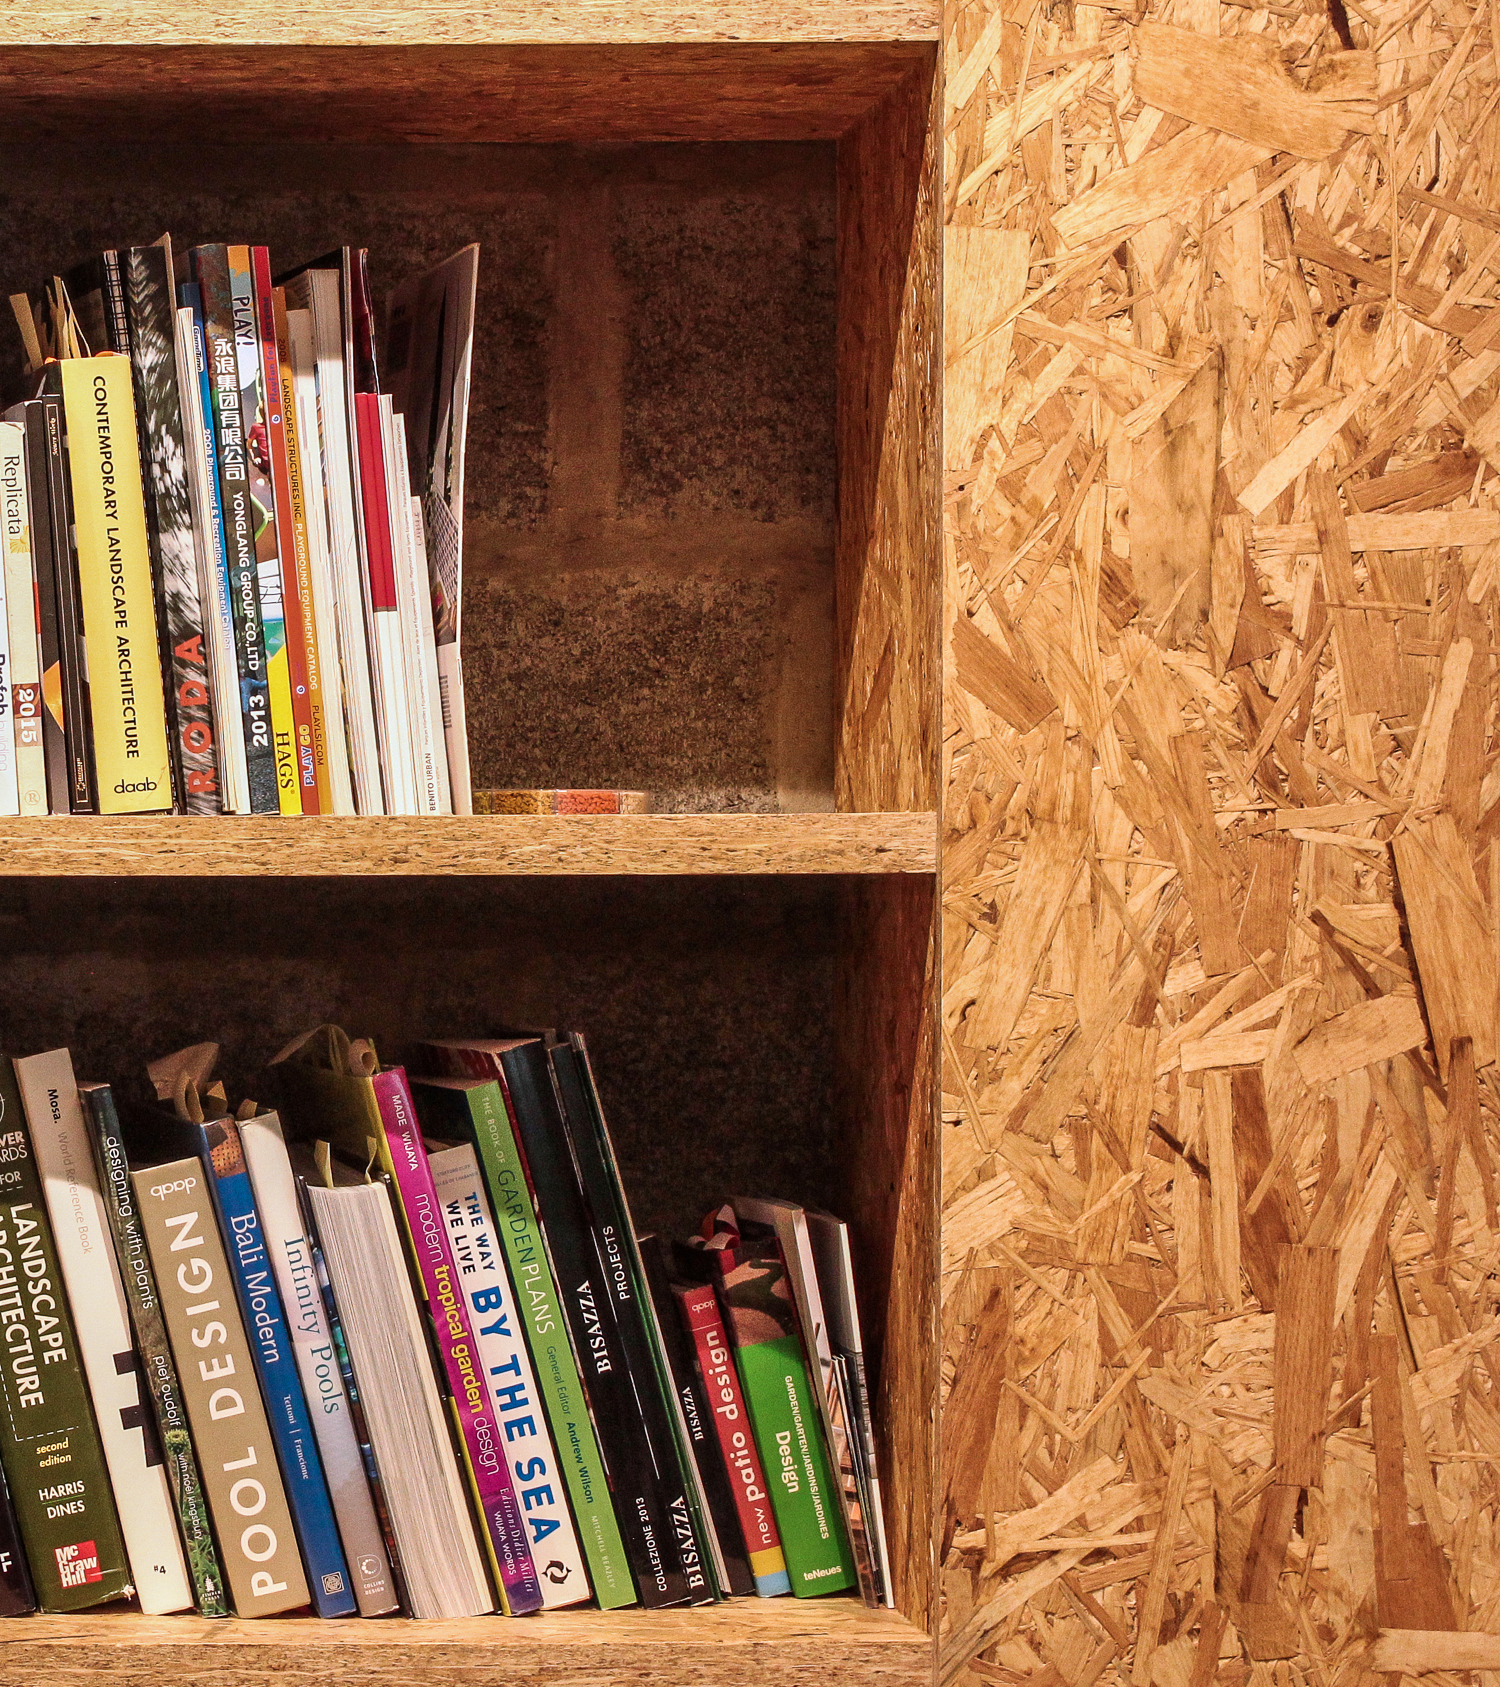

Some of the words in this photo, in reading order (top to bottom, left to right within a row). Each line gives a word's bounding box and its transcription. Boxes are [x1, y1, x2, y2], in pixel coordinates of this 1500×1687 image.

[231, 295, 256, 347] PLAY!
[278, 338, 287, 363] 2008
[214, 338, 246, 481] 永浪集团有限公司
[281, 378, 294, 435] LANDSCAPE
[92, 375, 119, 521] CONTEMPORARY
[203, 428, 213, 455] 2008
[287, 437, 300, 500] STRUCTURES
[1, 454, 22, 535] Replicata
[205, 457, 218, 508] Playground
[233, 491, 251, 568] YONGLANG
[293, 502, 303, 521] INC.
[212, 517, 224, 565] Recreation
[295, 522, 309, 588] PLAYGROUND
[106, 527, 129, 630] LANDSCAPE
[215, 566, 229, 614] Equipment
[240, 571, 255, 624] GROUP
[221, 615, 232, 650] Catalog
[301, 589, 314, 645] EQUIPMENT
[116, 635, 140, 759] ARCHITECTURE
[306, 646, 318, 691] CATALOG
[17, 688, 37, 744] 2015
[174, 634, 217, 794] RODA
[248, 694, 269, 748] 2013
[312, 705, 324, 766] PLAYLSI.COM
[114, 776, 158, 794] daab
[424, 752, 434, 781] URBAN
[426, 782, 437, 811] BENITO
[391, 1094, 407, 1127] MADE
[401, 1131, 419, 1171] WIJAYA
[481, 1096, 493, 1116] THE
[487, 1118, 501, 1148] BOOK
[495, 1150, 506, 1164] OF
[47, 1088, 63, 1124] Mosa.
[57, 1131, 74, 1166] World
[66, 1168, 86, 1223] Reference
[78, 1226, 94, 1255] Book
[106, 1136, 133, 1217] designing
[150, 1176, 196, 1201] daab
[125, 1220, 143, 1255] with
[230, 1209, 264, 1267] Bali
[445, 1199, 465, 1228] WE
[464, 1191, 484, 1227] THE
[475, 1232, 496, 1270] WAY
[454, 1234, 477, 1275] LIVE
[602, 1225, 631, 1300] PROJECTS
[10, 1202, 68, 1365] LANDSCAPE
[130, 1258, 155, 1310] plants
[470, 1285, 512, 1337] BY
[164, 1210, 246, 1421] DESIGN
[244, 1270, 280, 1364] Modern
[284, 1235, 321, 1334] Infinity
[310, 1343, 344, 1415] Pools
[414, 1192, 445, 1262] modern
[433, 1263, 465, 1340] tropical
[451, 1343, 485, 1413] garden
[472, 1417, 500, 1475] design
[575, 1279, 613, 1374] BISAZZA
[152, 1355, 171, 1381] piet
[705, 1330, 740, 1420] design
[161, 1383, 182, 1426] oudolf
[489, 1353, 538, 1443] THE
[546, 1345, 565, 1385] General
[556, 1386, 573, 1415] Editor
[566, 1421, 585, 1464] Andrew
[578, 1465, 595, 1504] Wilson
[681, 1386, 705, 1441] BISAZZA
[36, 1436, 70, 1454] second
[39, 1453, 72, 1468] edition
[283, 1394, 297, 1424] Tettoni
[293, 1438, 309, 1480] Francione
[775, 1430, 800, 1494] Design
[784, 1375, 830, 1540] GARDEN/GARTEN/JARDINS/JARDINES
[38, 1480, 85, 1501] HARRIS
[729, 1431, 766, 1503] patio
[46, 1499, 86, 1519] DINES
[178, 1452, 188, 1472] with
[187, 1496, 204, 1540] kingsbury
[222, 1446, 288, 1598] POOL
[499, 1487, 517, 1528] Editions
[510, 1529, 527, 1561] Didier
[514, 1456, 561, 1544] SEA
[635, 1496, 650, 1522] 2013
[54, 1544, 79, 1563] Mc
[494, 1510, 508, 1542] WIJAYA
[502, 1542, 517, 1575] WORDS
[591, 1515, 607, 1553] MITCHELL
[601, 1555, 617, 1589] BEAZLEY
[669, 1495, 705, 1589] BISAZZA
[754, 1508, 772, 1545] new
[58, 1556, 97, 1574] Graw
[60, 1570, 87, 1588] Hill
[363, 1579, 385, 1589] COLLINS
[642, 1524, 668, 1592] COLLEZIONE
[803, 1565, 843, 1581] teNeues
[364, 1586, 385, 1596] DESIGN
